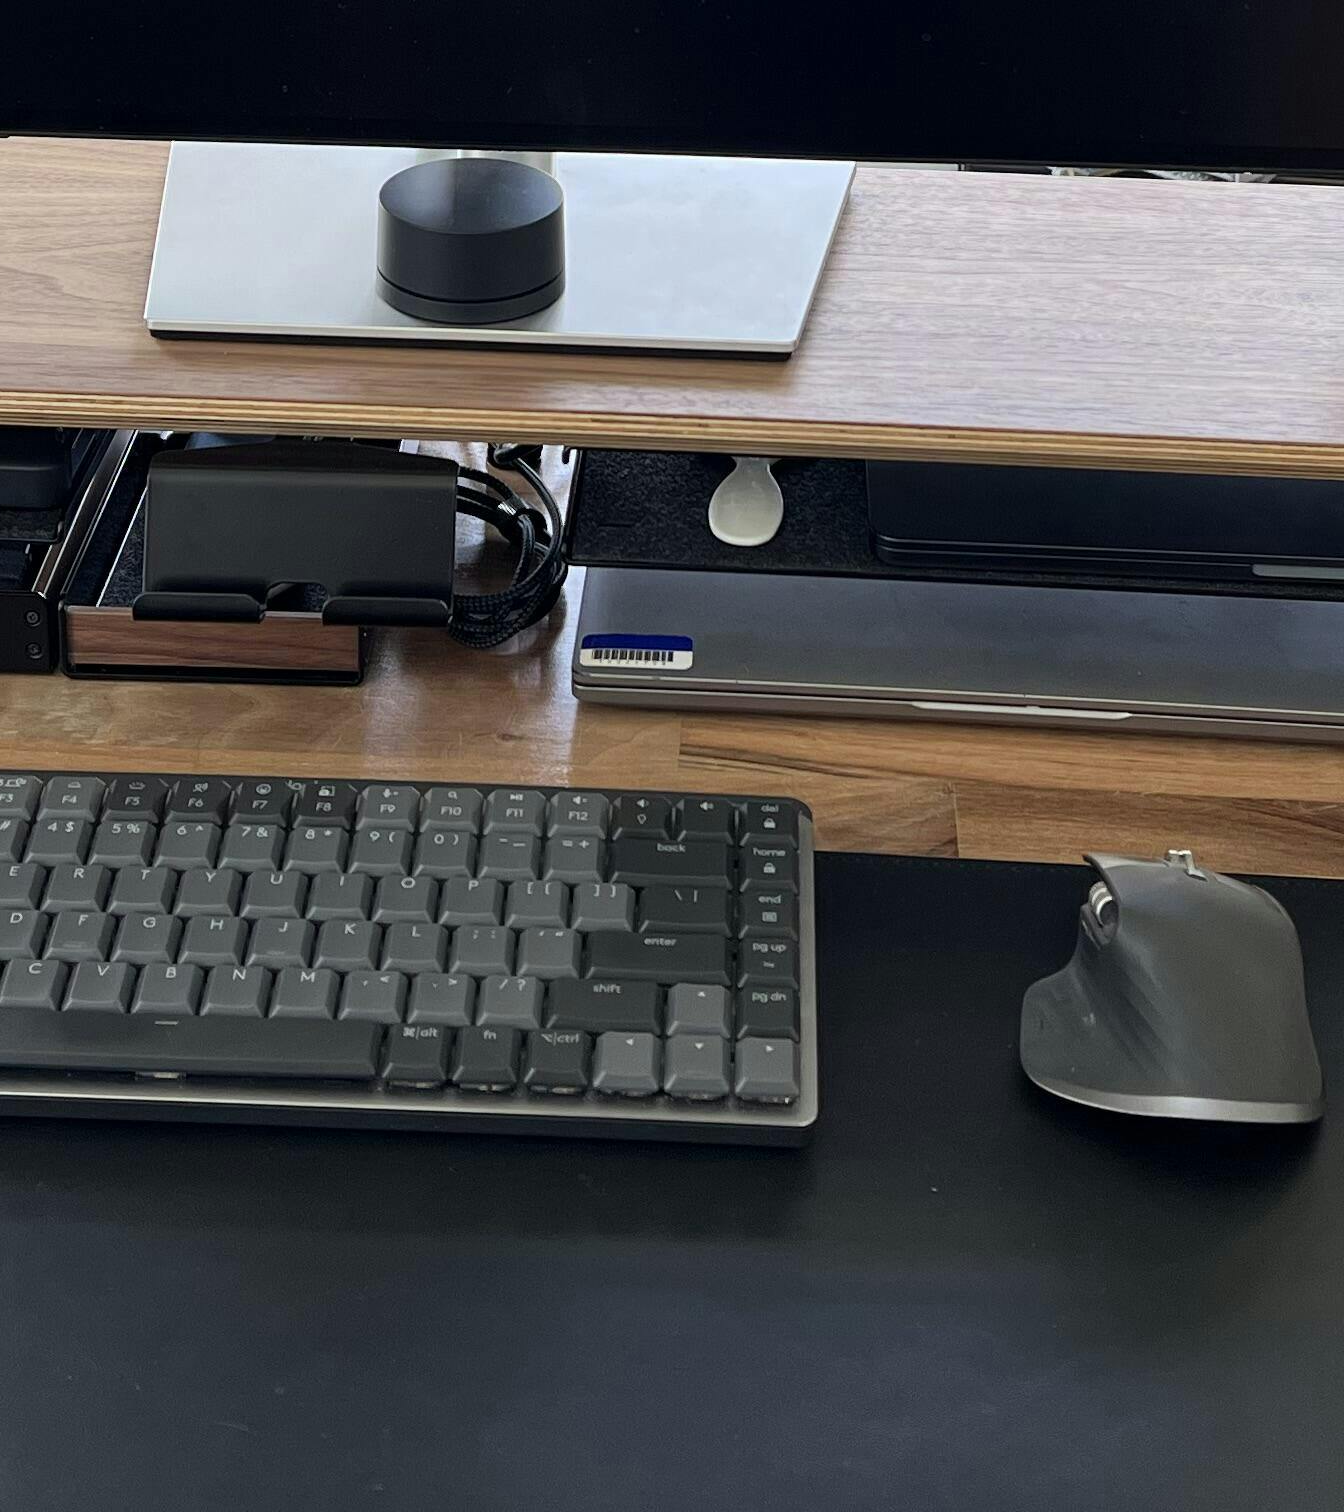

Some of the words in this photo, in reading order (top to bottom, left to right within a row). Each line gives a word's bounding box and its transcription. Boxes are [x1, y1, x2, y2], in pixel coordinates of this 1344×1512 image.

[62, 795, 78, 804] F4
[125, 796, 140, 806] F5
[188, 797, 204, 808] F6
[252, 800, 268, 809] F7
[316, 802, 332, 812] F8
[380, 804, 396, 814] F9
[441, 806, 462, 816] F10
[506, 808, 524, 817] F11
[568, 811, 589, 821] F12
[47, 822, 58, 832] 4
[111, 823, 121, 834] 5
[176, 825, 187, 835] 6
[241, 826, 252, 837] 7
[305, 829, 316, 840] 8
[369, 830, 380, 841] 9
[434, 833, 445, 845] 0
[656, 843, 686, 853] back
[752, 847, 787, 857] home
[9, 865, 21, 877] E
[74, 867, 85, 879] R
[140, 869, 151, 880] T
[205, 871, 217, 883] Y
[270, 873, 283, 885] U
[468, 880, 479, 891] P
[758, 894, 782, 904] end
[9, 912, 24, 924] D
[77, 914, 88, 926] F
[142, 916, 156, 929] G
[210, 918, 224, 931] H
[278, 921, 288, 933] J
[344, 923, 356, 935] K
[411, 925, 422, 937] L
[643, 937, 677, 947] enter
[752, 942, 768, 953] pg
[770, 943, 787, 954] up
[28, 962, 43, 975] C
[97, 965, 109, 977] V
[165, 967, 177, 979] B
[232, 968, 247, 980] N
[300, 971, 316, 983] M
[517, 979, 527, 991] ?
[593, 984, 622, 994] shift
[751, 991, 768, 1003] pg
[770, 991, 787, 1001] dn
[483, 1030, 497, 1040] fn
